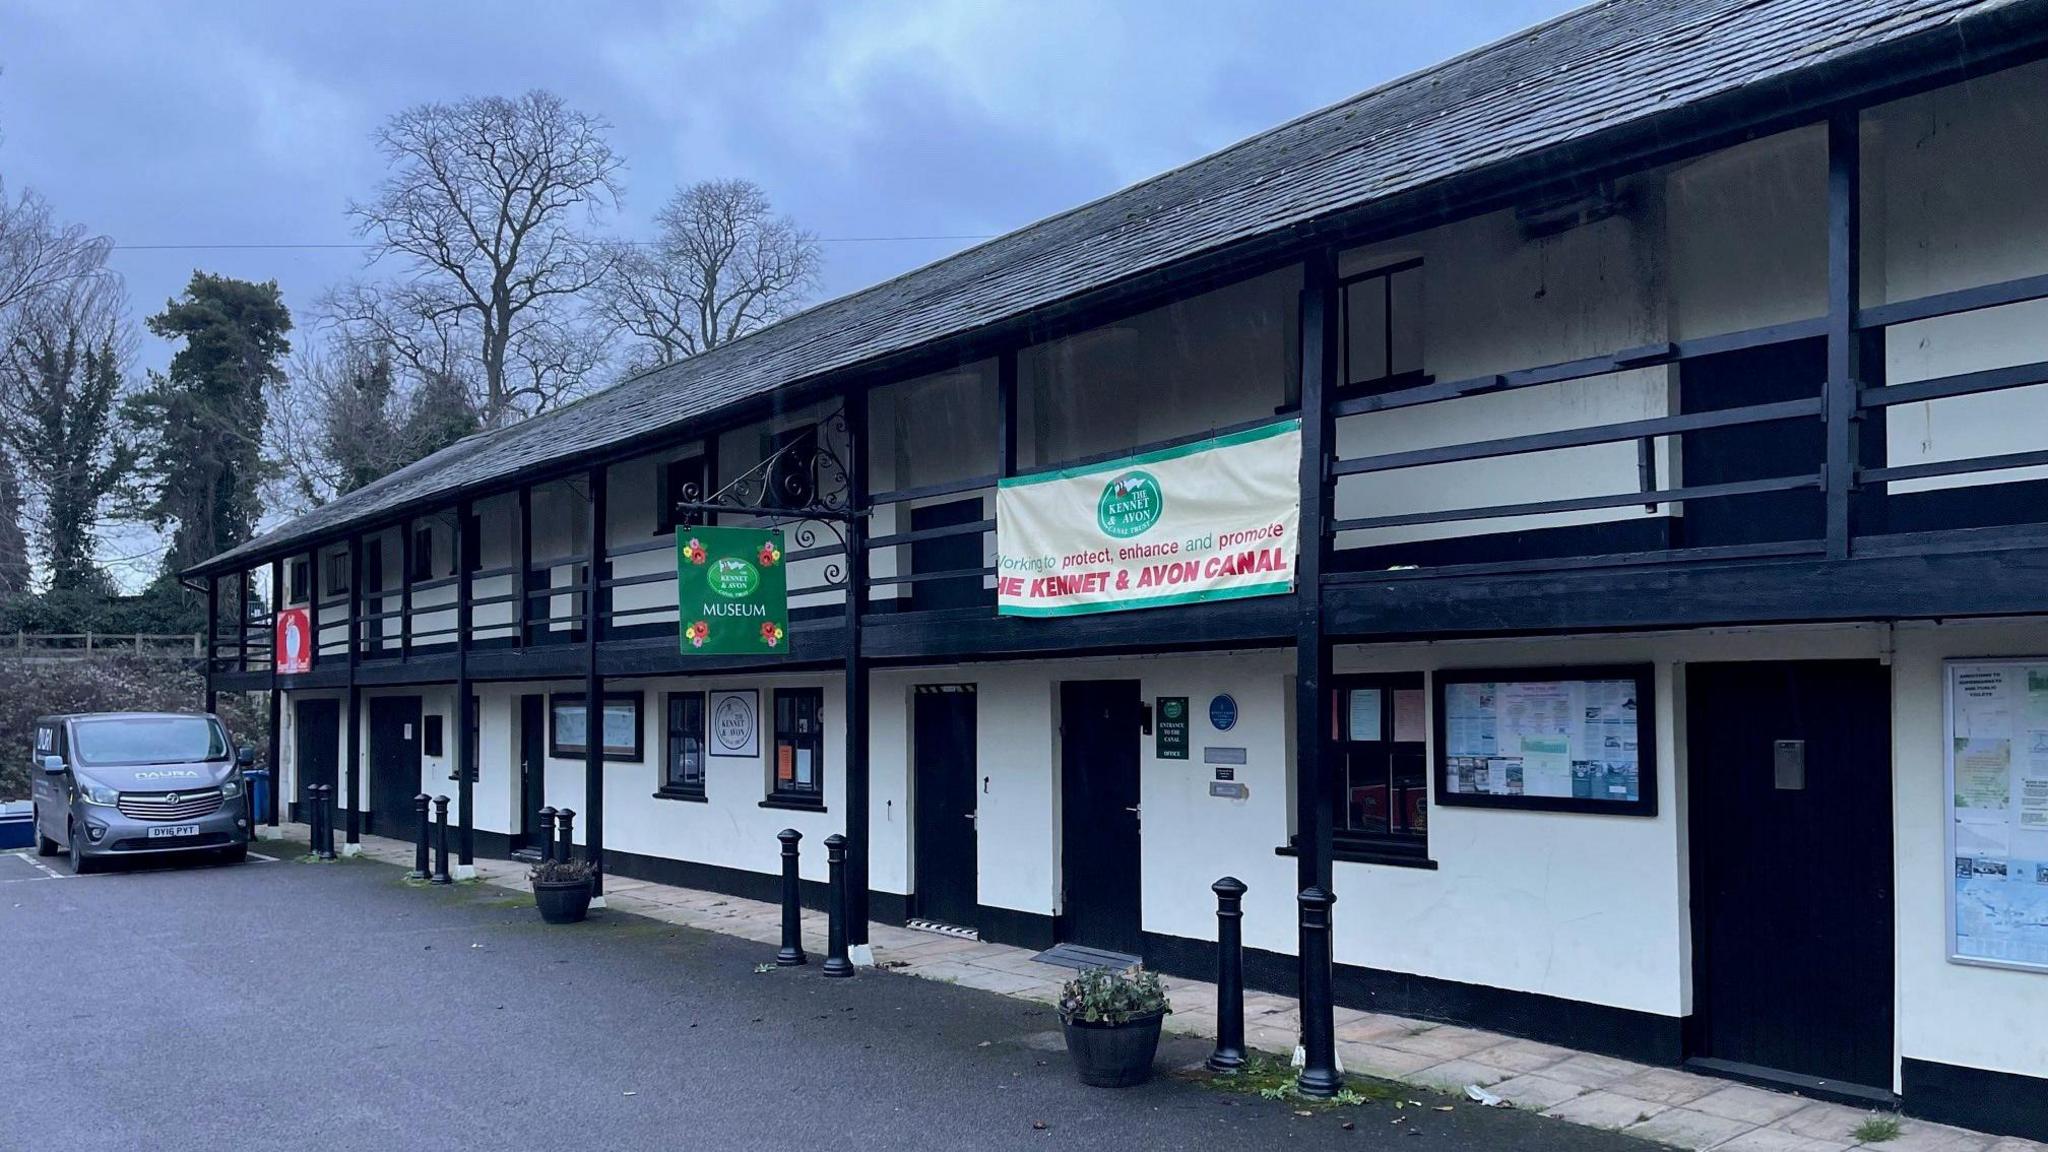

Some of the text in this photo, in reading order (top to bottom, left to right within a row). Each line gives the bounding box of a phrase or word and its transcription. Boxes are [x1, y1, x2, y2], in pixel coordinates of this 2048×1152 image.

[1131, 490, 1147, 500] THE
[1109, 498, 1149, 514] KENNET
[1107, 510, 1151, 526] & AVON
[1044, 554, 1056, 569] to
[1063, 548, 1114, 569] protect,
[1119, 537, 1179, 561] enhance
[1186, 533, 1212, 552] and
[1219, 522, 1284, 548] promote
[998, 547, 1287, 597] HE KENNET & AVON CANAL
[703, 603, 766, 617] MUSEUM
[721, 719, 744, 728] KENNET
[729, 728, 745, 736] AVON
[154, 826, 194, 837] DY16 PYT
